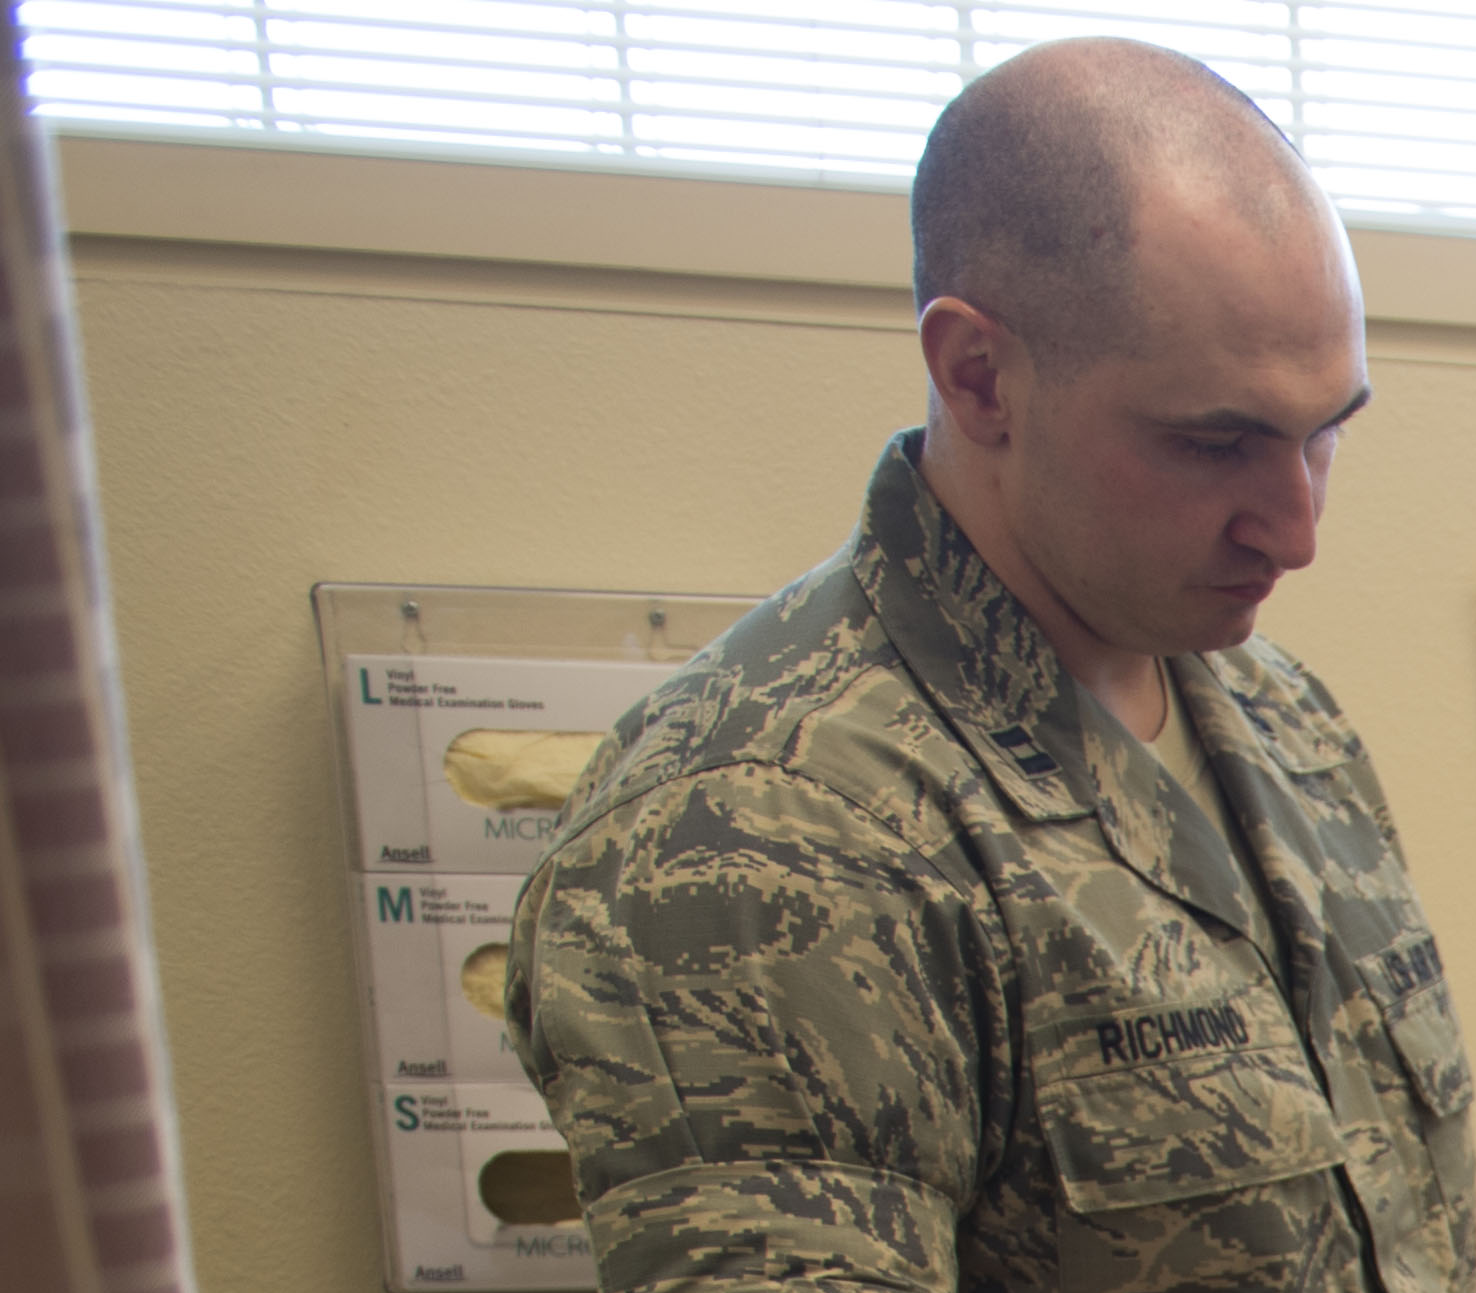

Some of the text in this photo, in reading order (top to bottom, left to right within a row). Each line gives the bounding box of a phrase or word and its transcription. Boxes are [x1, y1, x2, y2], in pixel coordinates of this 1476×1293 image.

[386, 669, 415, 682] Vinyl
[359, 667, 383, 706] L
[387, 683, 457, 695] Powder Free
[389, 696, 545, 710] Medical Examination Gloves
[484, 817, 554, 842] MICR
[380, 844, 431, 862] Ansell
[419, 887, 447, 899] Vinyl
[376, 886, 414, 923] M
[421, 901, 489, 911] Powder Free
[421, 913, 466, 924] Medical
[1098, 1003, 1249, 1064] RICHMOND
[397, 1060, 447, 1074] Ansell
[420, 1095, 448, 1107] Vinyl
[394, 1094, 420, 1132] S
[422, 1108, 490, 1119] Powder Free
[423, 1120, 467, 1131] Medical
[470, 1120, 536, 1131] Examination
[415, 1264, 464, 1281] Ansell
